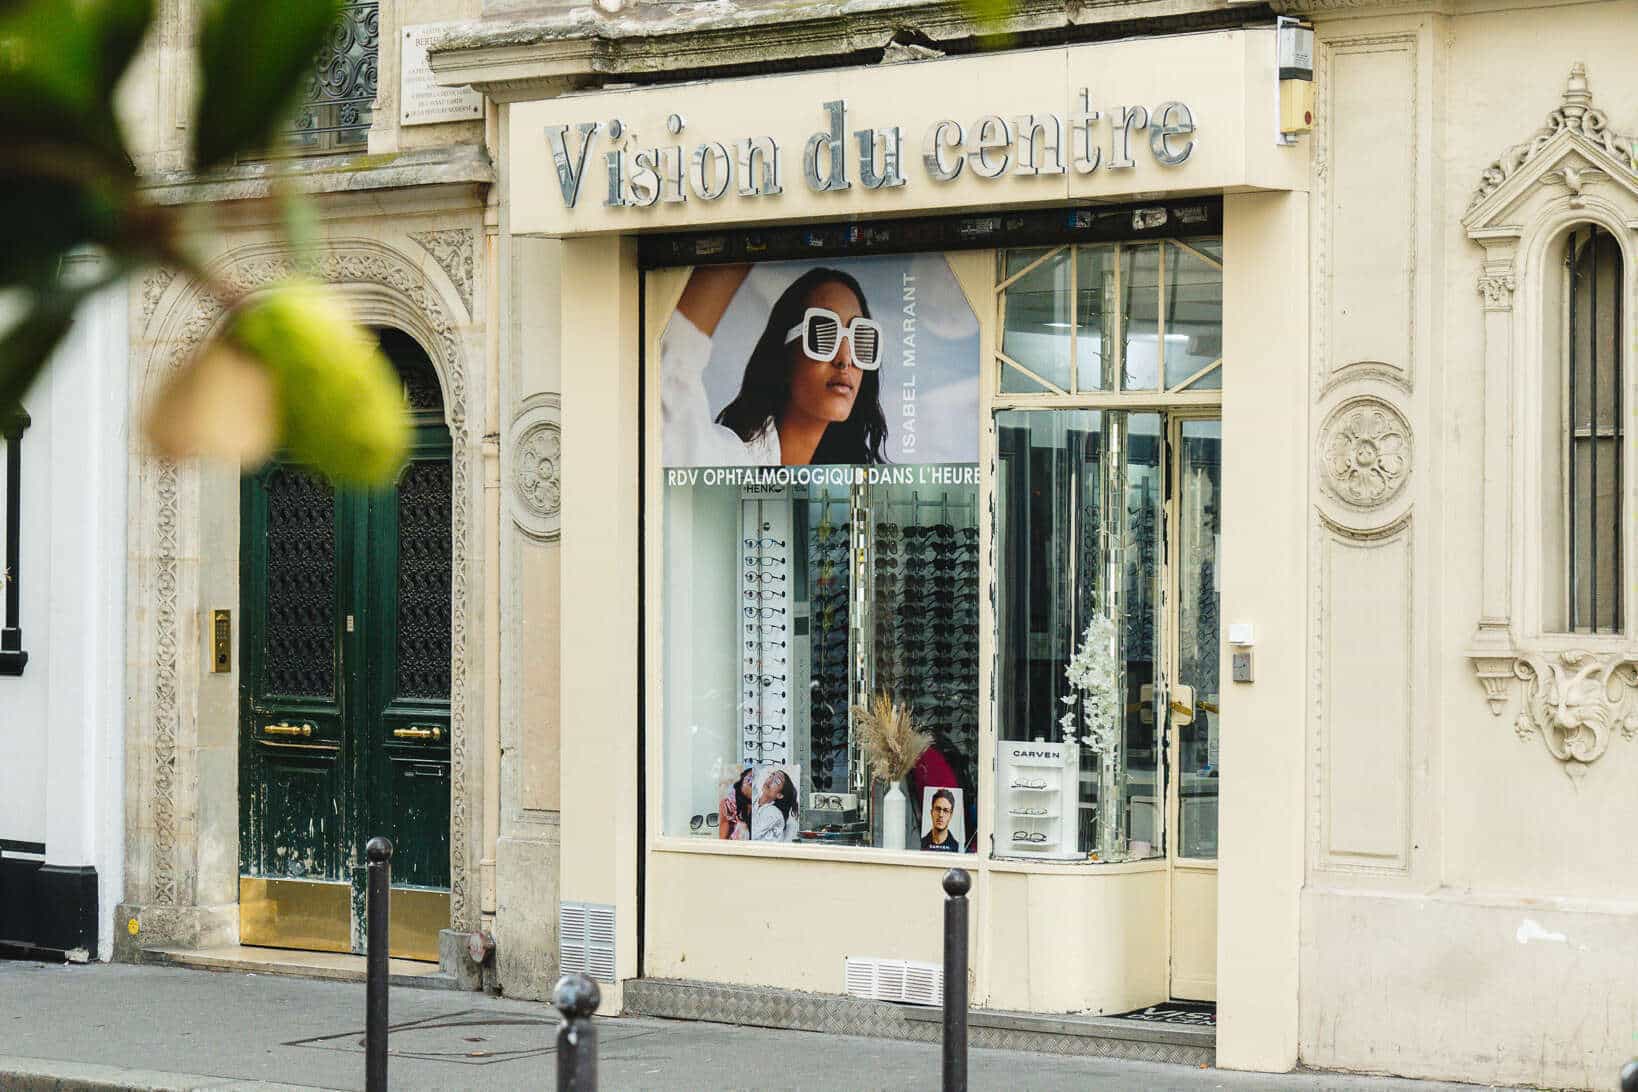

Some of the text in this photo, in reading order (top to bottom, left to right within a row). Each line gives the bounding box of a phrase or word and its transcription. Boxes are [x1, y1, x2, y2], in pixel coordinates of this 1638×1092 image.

[544, 87, 1196, 208] Vision du centre
[902, 272, 916, 453] ISABEL MARANT
[668, 466, 980, 487] RDV OPHTALMOLOGIQUE DANS L'HEURE
[1013, 750, 1060, 759] CARVEN
